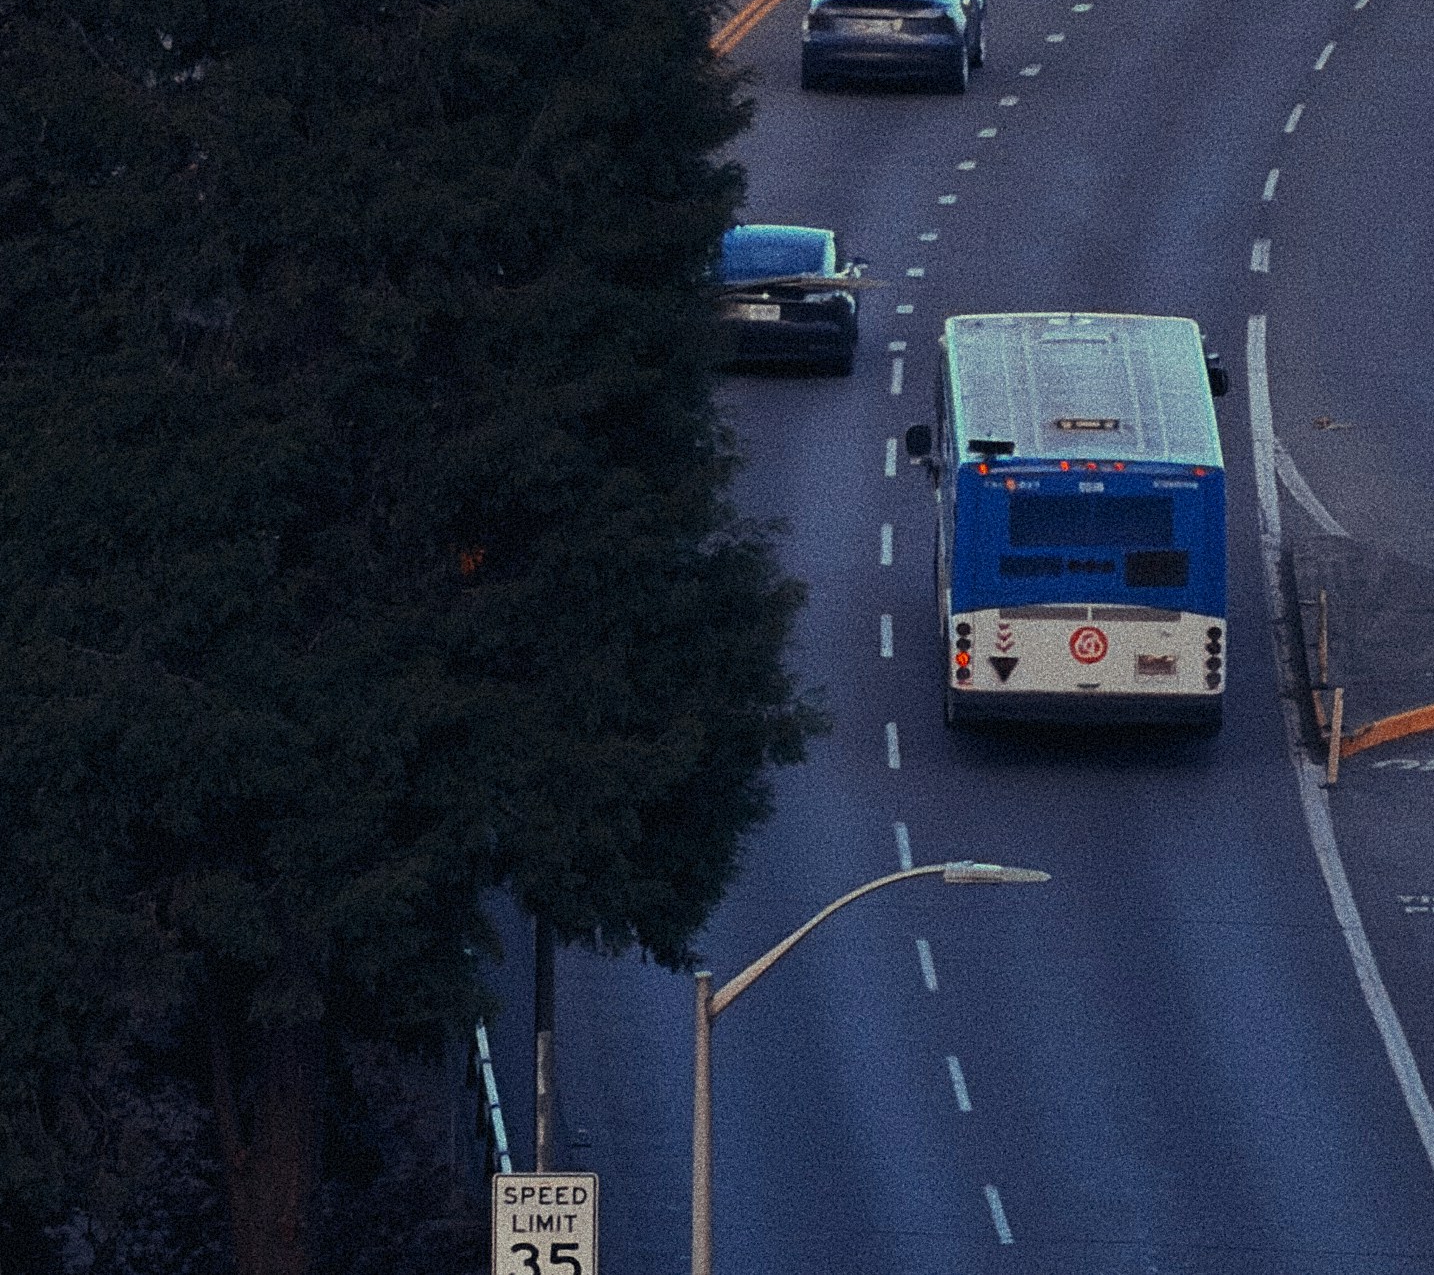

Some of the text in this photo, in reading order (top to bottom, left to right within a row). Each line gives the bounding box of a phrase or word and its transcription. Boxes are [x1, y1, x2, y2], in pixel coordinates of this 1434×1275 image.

[503, 1185, 588, 1205] SPEED
[511, 1213, 577, 1234] LIMIT
[510, 1242, 582, 1275] 35
